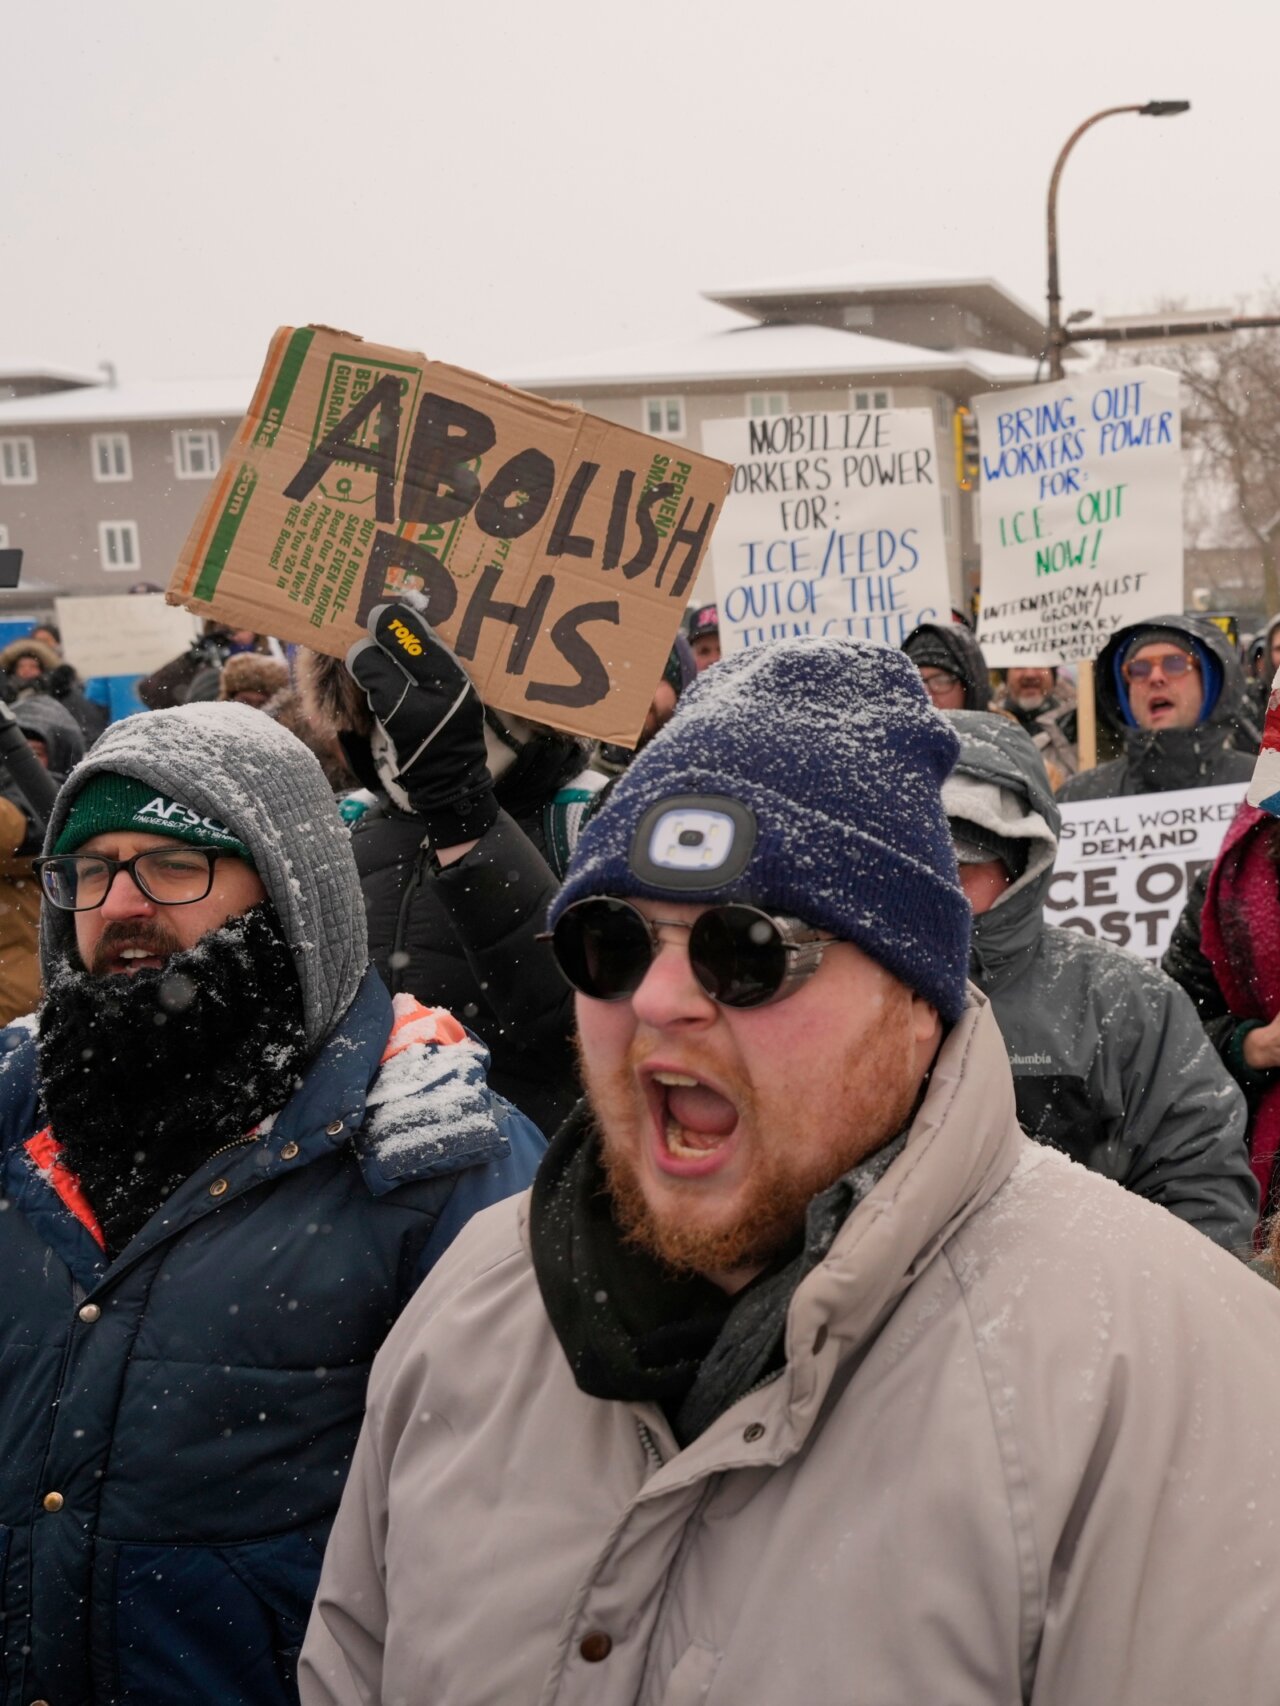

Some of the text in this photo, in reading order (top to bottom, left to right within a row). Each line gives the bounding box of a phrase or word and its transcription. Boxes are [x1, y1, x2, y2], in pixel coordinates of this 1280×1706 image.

[749, 412, 894, 456] MOBILIZE
[997, 380, 1146, 447] BRING OUT
[983, 410, 1174, 482] WORKERS POWER
[282, 374, 716, 598] ABOLISH
[638, 453, 672, 509] SMA
[727, 447, 934, 495] ORKERS POWER
[1039, 466, 1090, 501] FOR:
[310, 504, 333, 543] Prices
[1076, 483, 1129, 526] OUT
[268, 504, 302, 571] REE Boxes!
[291, 529, 307, 552] You
[300, 544, 316, 570] and
[301, 508, 346, 607] Beat Our Bundle
[1035, 527, 1103, 577] NOW!
[309, 513, 360, 629] SAVE EVEN MORE!
[841, 572, 910, 614] THE
[983, 572, 1148, 621] INTERNATIONALIST
[354, 529, 620, 709] DHS
[387, 618, 423, 656] TOKO
[1013, 631, 1111, 655] INTERNATIO
[137, 796, 230, 835] AFSC
[1060, 816, 1129, 840] STAL
[1081, 828, 1198, 857] DEMAND
[1044, 866, 1118, 912] CE
[1056, 909, 1171, 948] OST
[1008, 1049, 1052, 1065] olumbia
